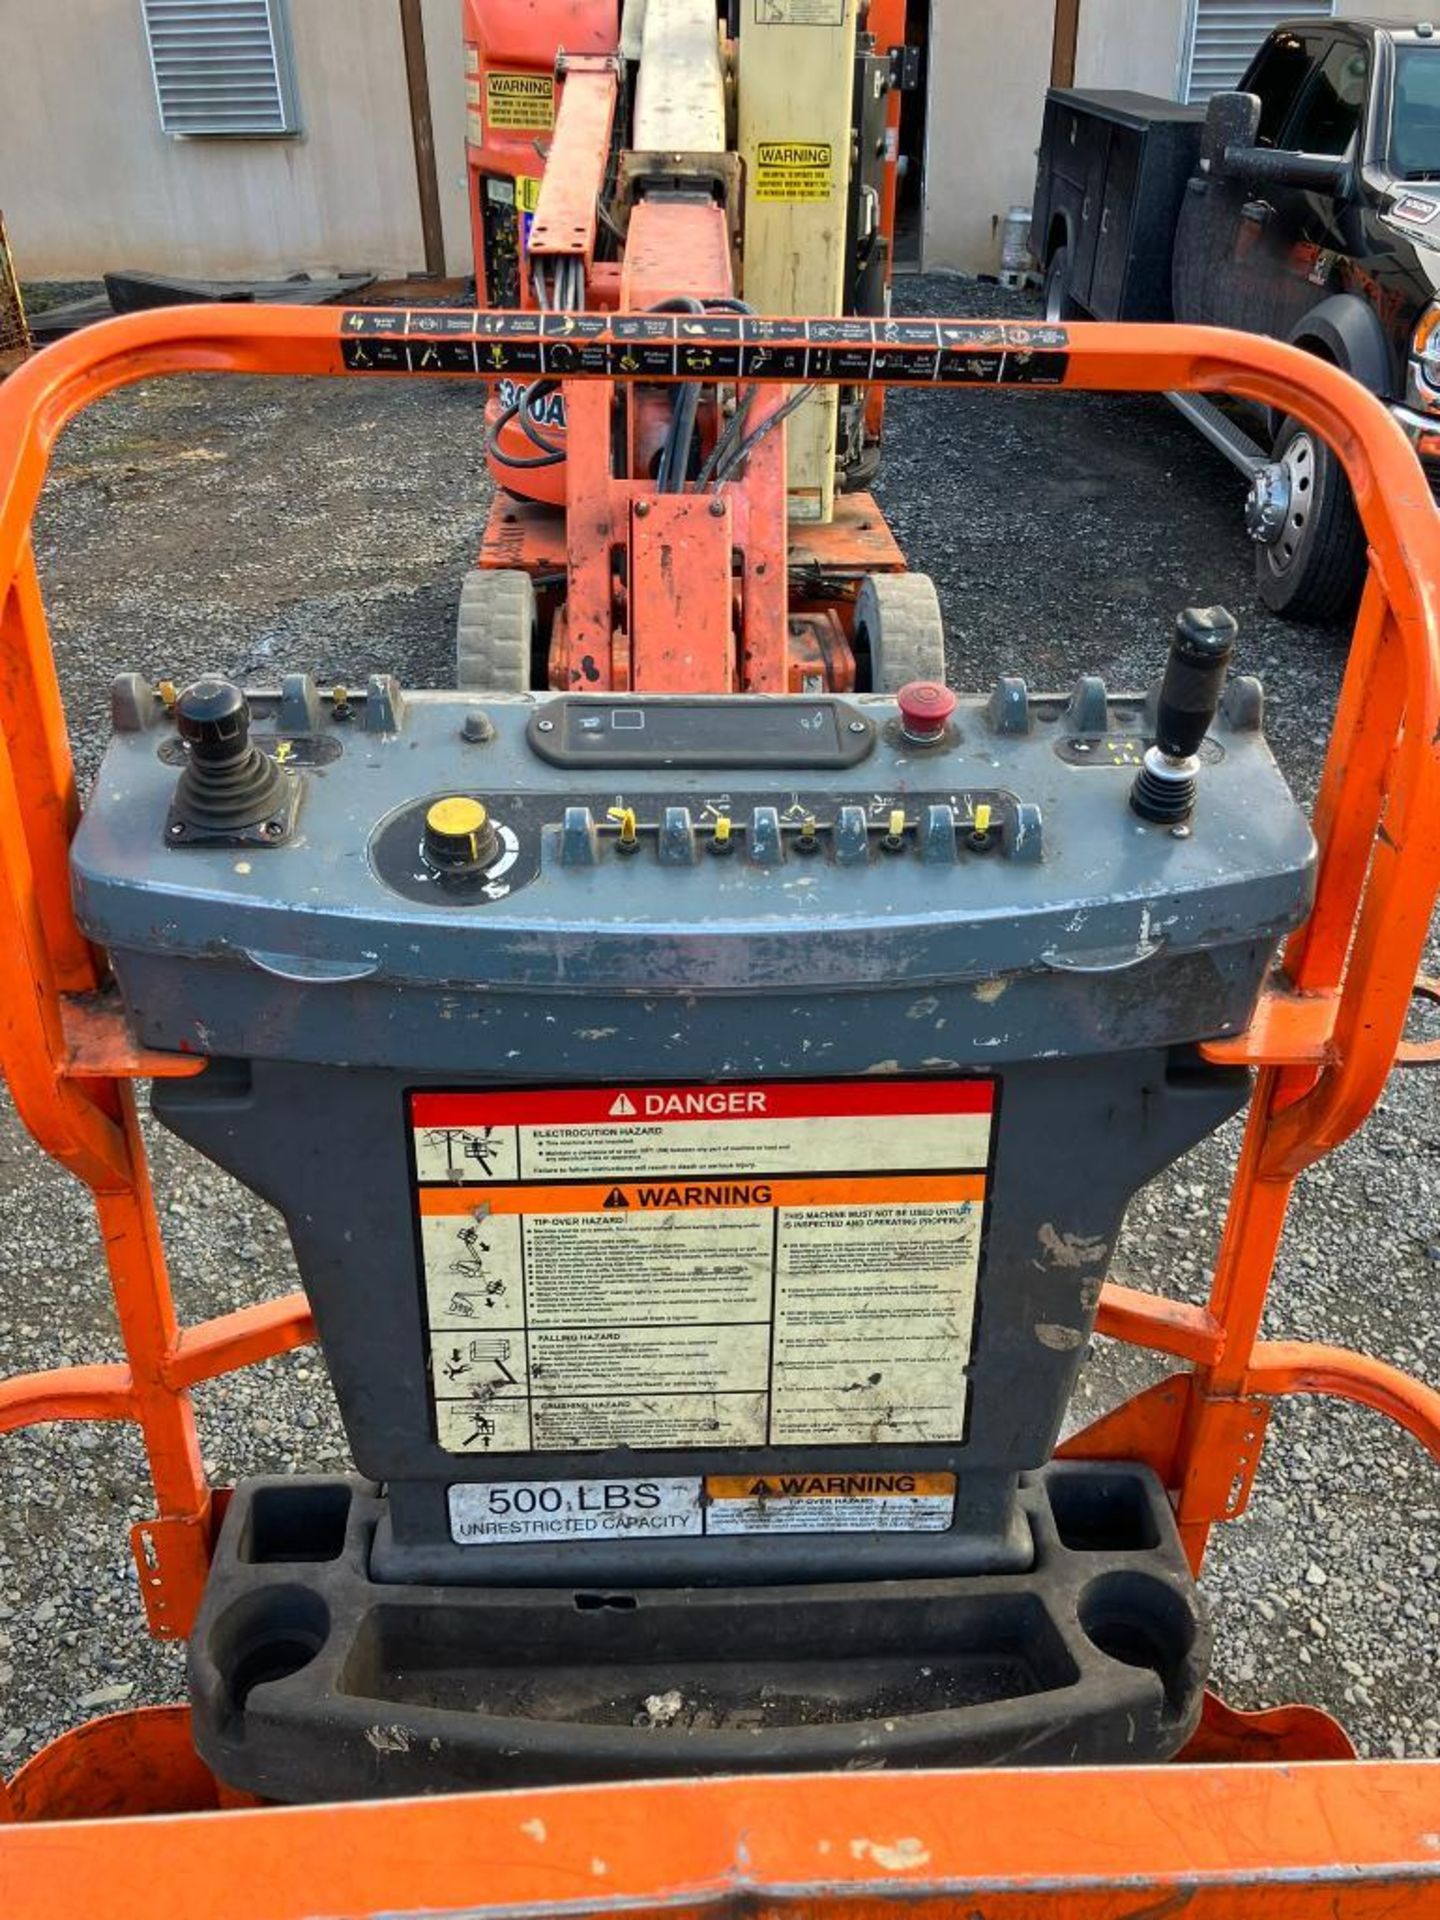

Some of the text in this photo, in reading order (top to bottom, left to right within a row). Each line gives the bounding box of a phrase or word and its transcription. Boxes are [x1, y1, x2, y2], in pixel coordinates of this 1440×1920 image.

[491, 79, 550, 93] WARNING
[761, 149, 828, 162] WARNING
[645, 1092, 767, 1115] DANGER
[533, 1127, 663, 1138] ELECTROCUTION HAZARD
[638, 1185, 772, 1207] WARNING
[806, 1211, 846, 1219] MACHINE
[848, 1210, 872, 1218] MUST
[875, 1209, 893, 1217] NOT
[895, 1209, 907, 1217] BE
[910, 1208, 934, 1216] USED
[533, 1217, 624, 1227] TIP-OVER HAZARD
[793, 1220, 844, 1229] INSPECTED
[845, 1219, 865, 1228] AND
[866, 1218, 918, 1227] OPERATING
[538, 1333, 620, 1342] FALLING HAZARD
[591, 1400, 631, 1409] HAZARD
[780, 1475, 916, 1495] WARNING
[488, 1483, 662, 1515] 500 LBS
[459, 1518, 597, 1537] UNRESTRICTED
[602, 1514, 690, 1531] CAPACITY
